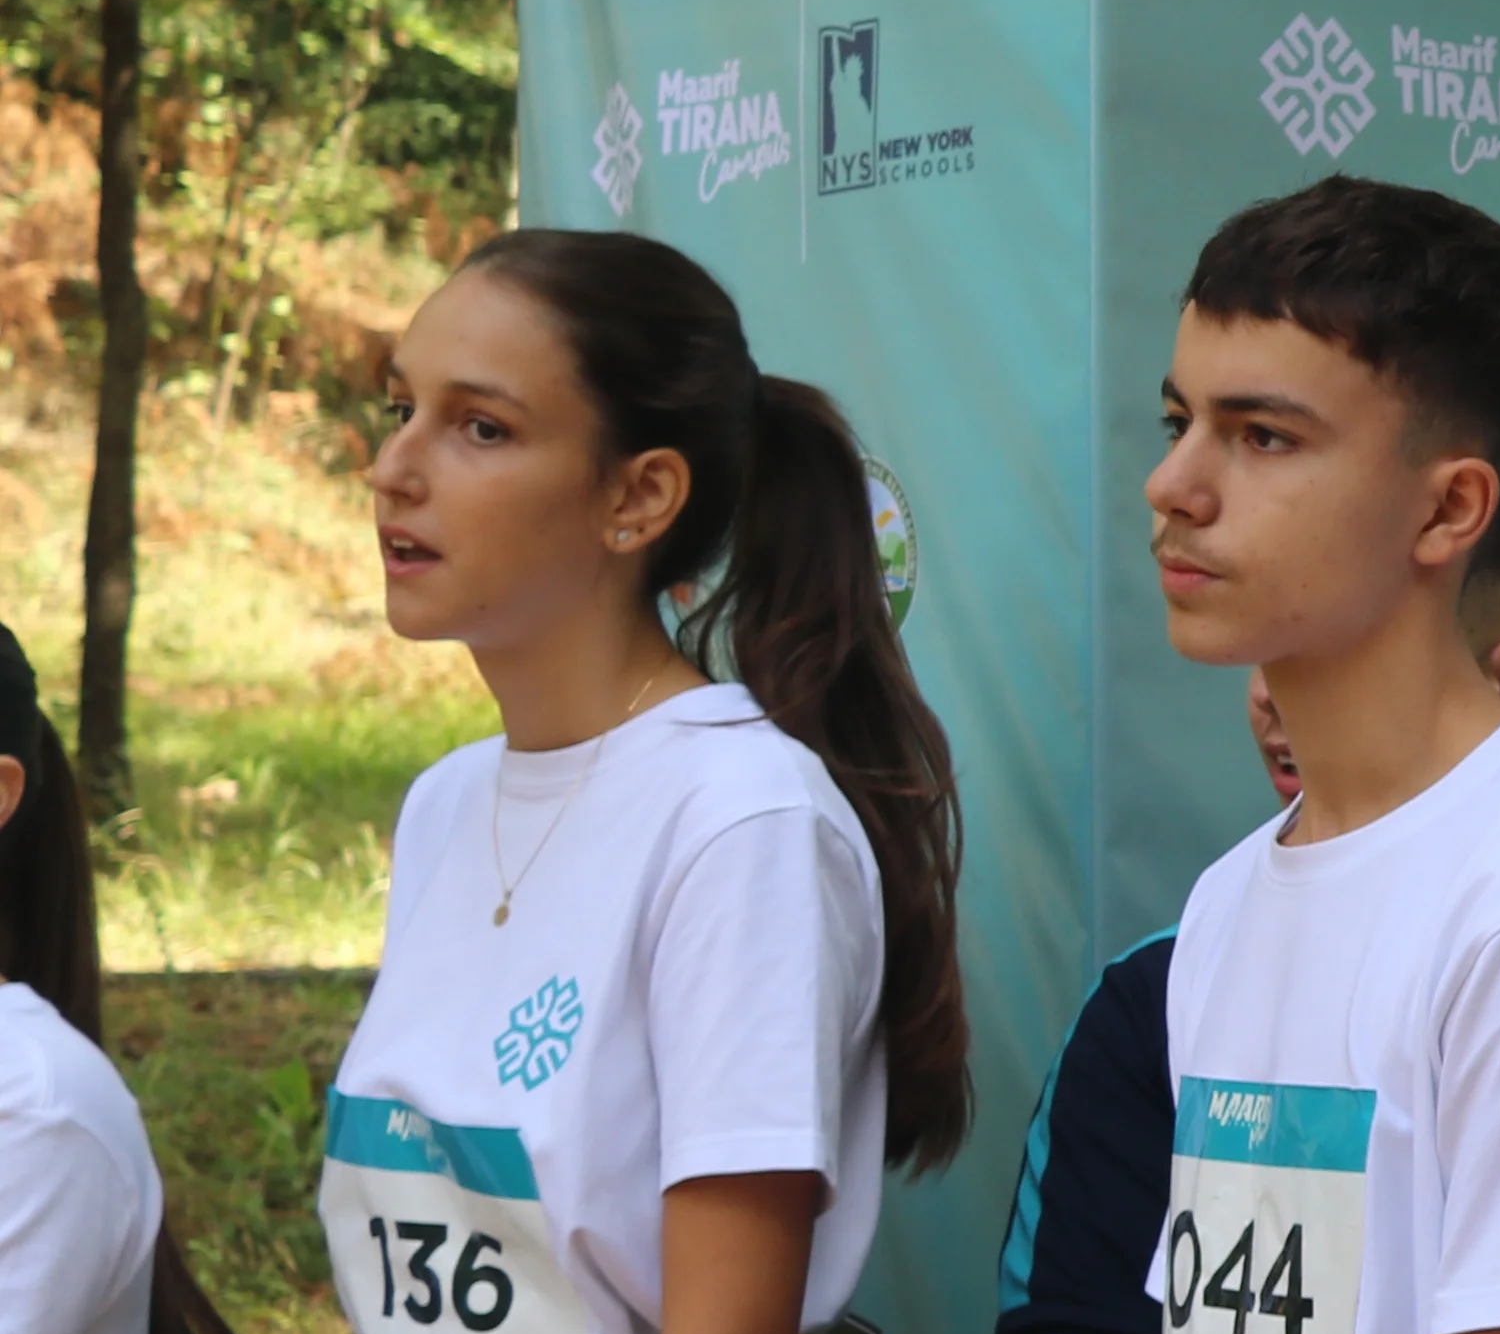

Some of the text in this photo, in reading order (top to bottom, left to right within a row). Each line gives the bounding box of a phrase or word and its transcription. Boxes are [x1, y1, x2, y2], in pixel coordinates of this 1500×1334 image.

[1392, 24, 1497, 73] Maarif
[657, 59, 742, 107] Maarif
[657, 92, 783, 156] TIRANA
[879, 126, 974, 161] NEW YORK
[700, 133, 791, 203] Campus
[822, 151, 874, 187] NYS
[879, 152, 975, 185] SCHOOLS
[369, 1216, 514, 1333] 136
